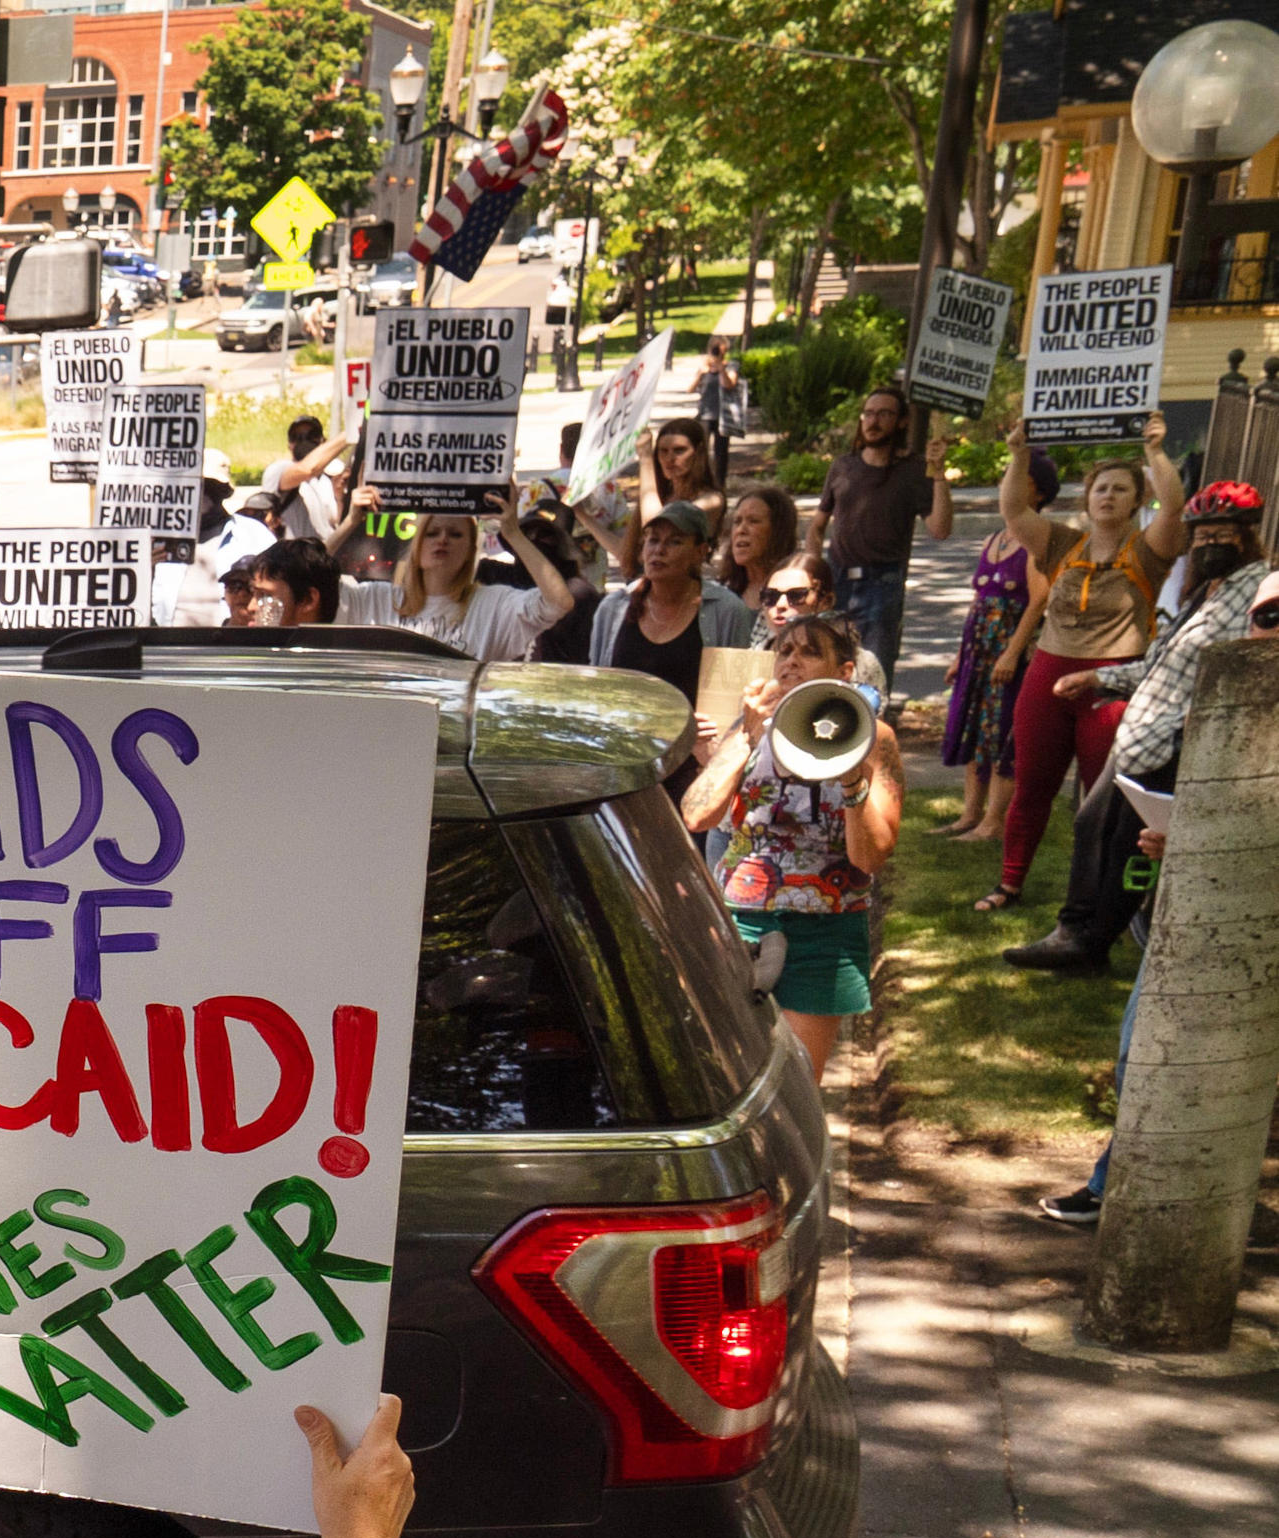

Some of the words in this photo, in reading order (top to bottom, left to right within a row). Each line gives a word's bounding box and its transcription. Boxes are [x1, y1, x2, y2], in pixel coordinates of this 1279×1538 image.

[958, 281, 1006, 306] PUEBLO
[1045, 282, 1082, 302] THE
[1087, 275, 1161, 298] PEOPLE
[938, 294, 996, 330] UNIDO
[1042, 298, 1158, 334] UNITED
[428, 318, 514, 341] PUEBLO
[1040, 334, 1080, 352] WILL
[1085, 328, 1155, 350] DEFEND
[74, 337, 131, 355] PUEBLO
[57, 358, 123, 384] UNIDO
[395, 344, 500, 378] UNIDO
[1035, 362, 1153, 388] IMMIGRANT
[387, 376, 504, 401] DEFENDERÁ
[1032, 385, 1149, 412] FAMILIES!
[112, 394, 141, 412] THE
[145, 393, 201, 413] PEOPLE
[62, 422, 80, 433] LAS
[109, 416, 199, 449] UNITED
[375, 432, 387, 448] A
[392, 432, 422, 449] LAS
[428, 433, 507, 450] FAMILIAS
[107, 450, 139, 466] WILL
[144, 450, 197, 468] DEFEND
[374, 452, 504, 474] MIGRANTES!
[102, 484, 195, 505] IMMIGRANT
[99, 506, 191, 532] FAMILIES!
[50, 540, 139, 563] PEOPLE
[53, 608, 136, 628] DEFEND
